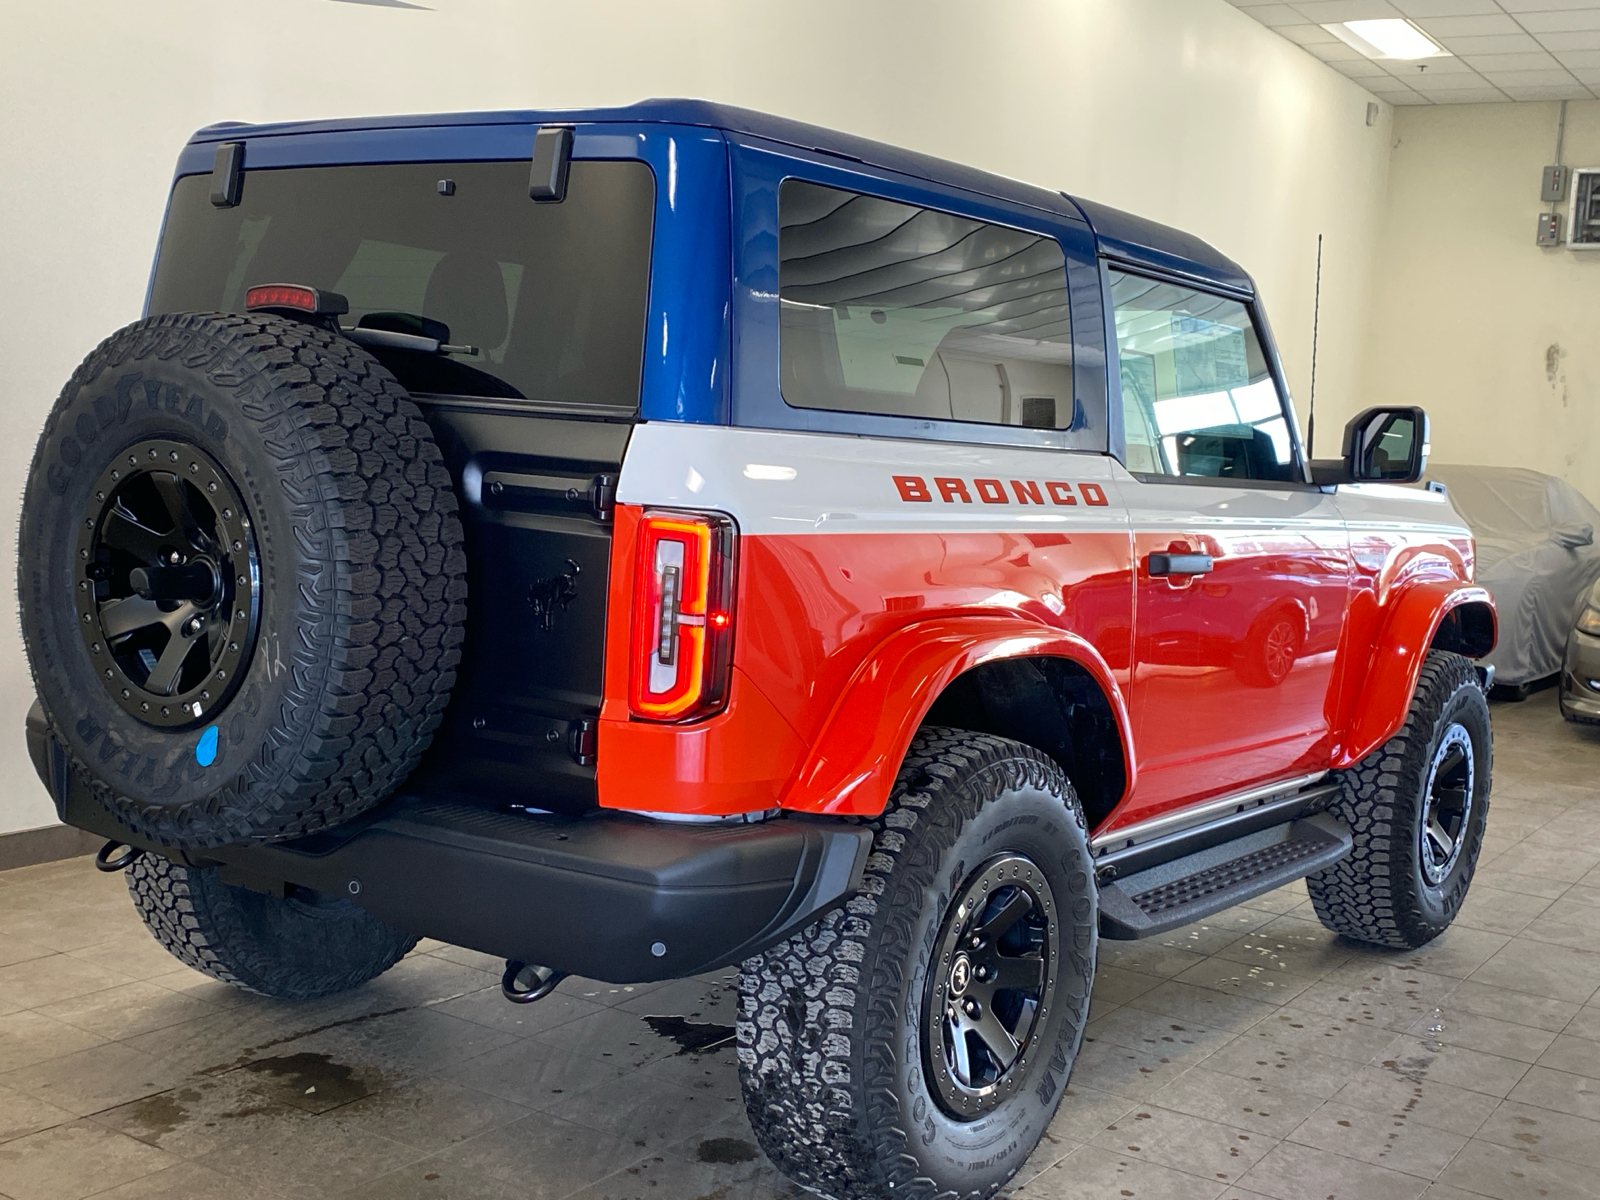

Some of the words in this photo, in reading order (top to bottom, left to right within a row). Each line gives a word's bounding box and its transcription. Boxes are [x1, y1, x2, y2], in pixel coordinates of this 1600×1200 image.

[47, 371, 229, 496] GOODYEAR
[892, 475, 1109, 506] BRONCO
[1036, 848, 1092, 1107] GOODYEAR
